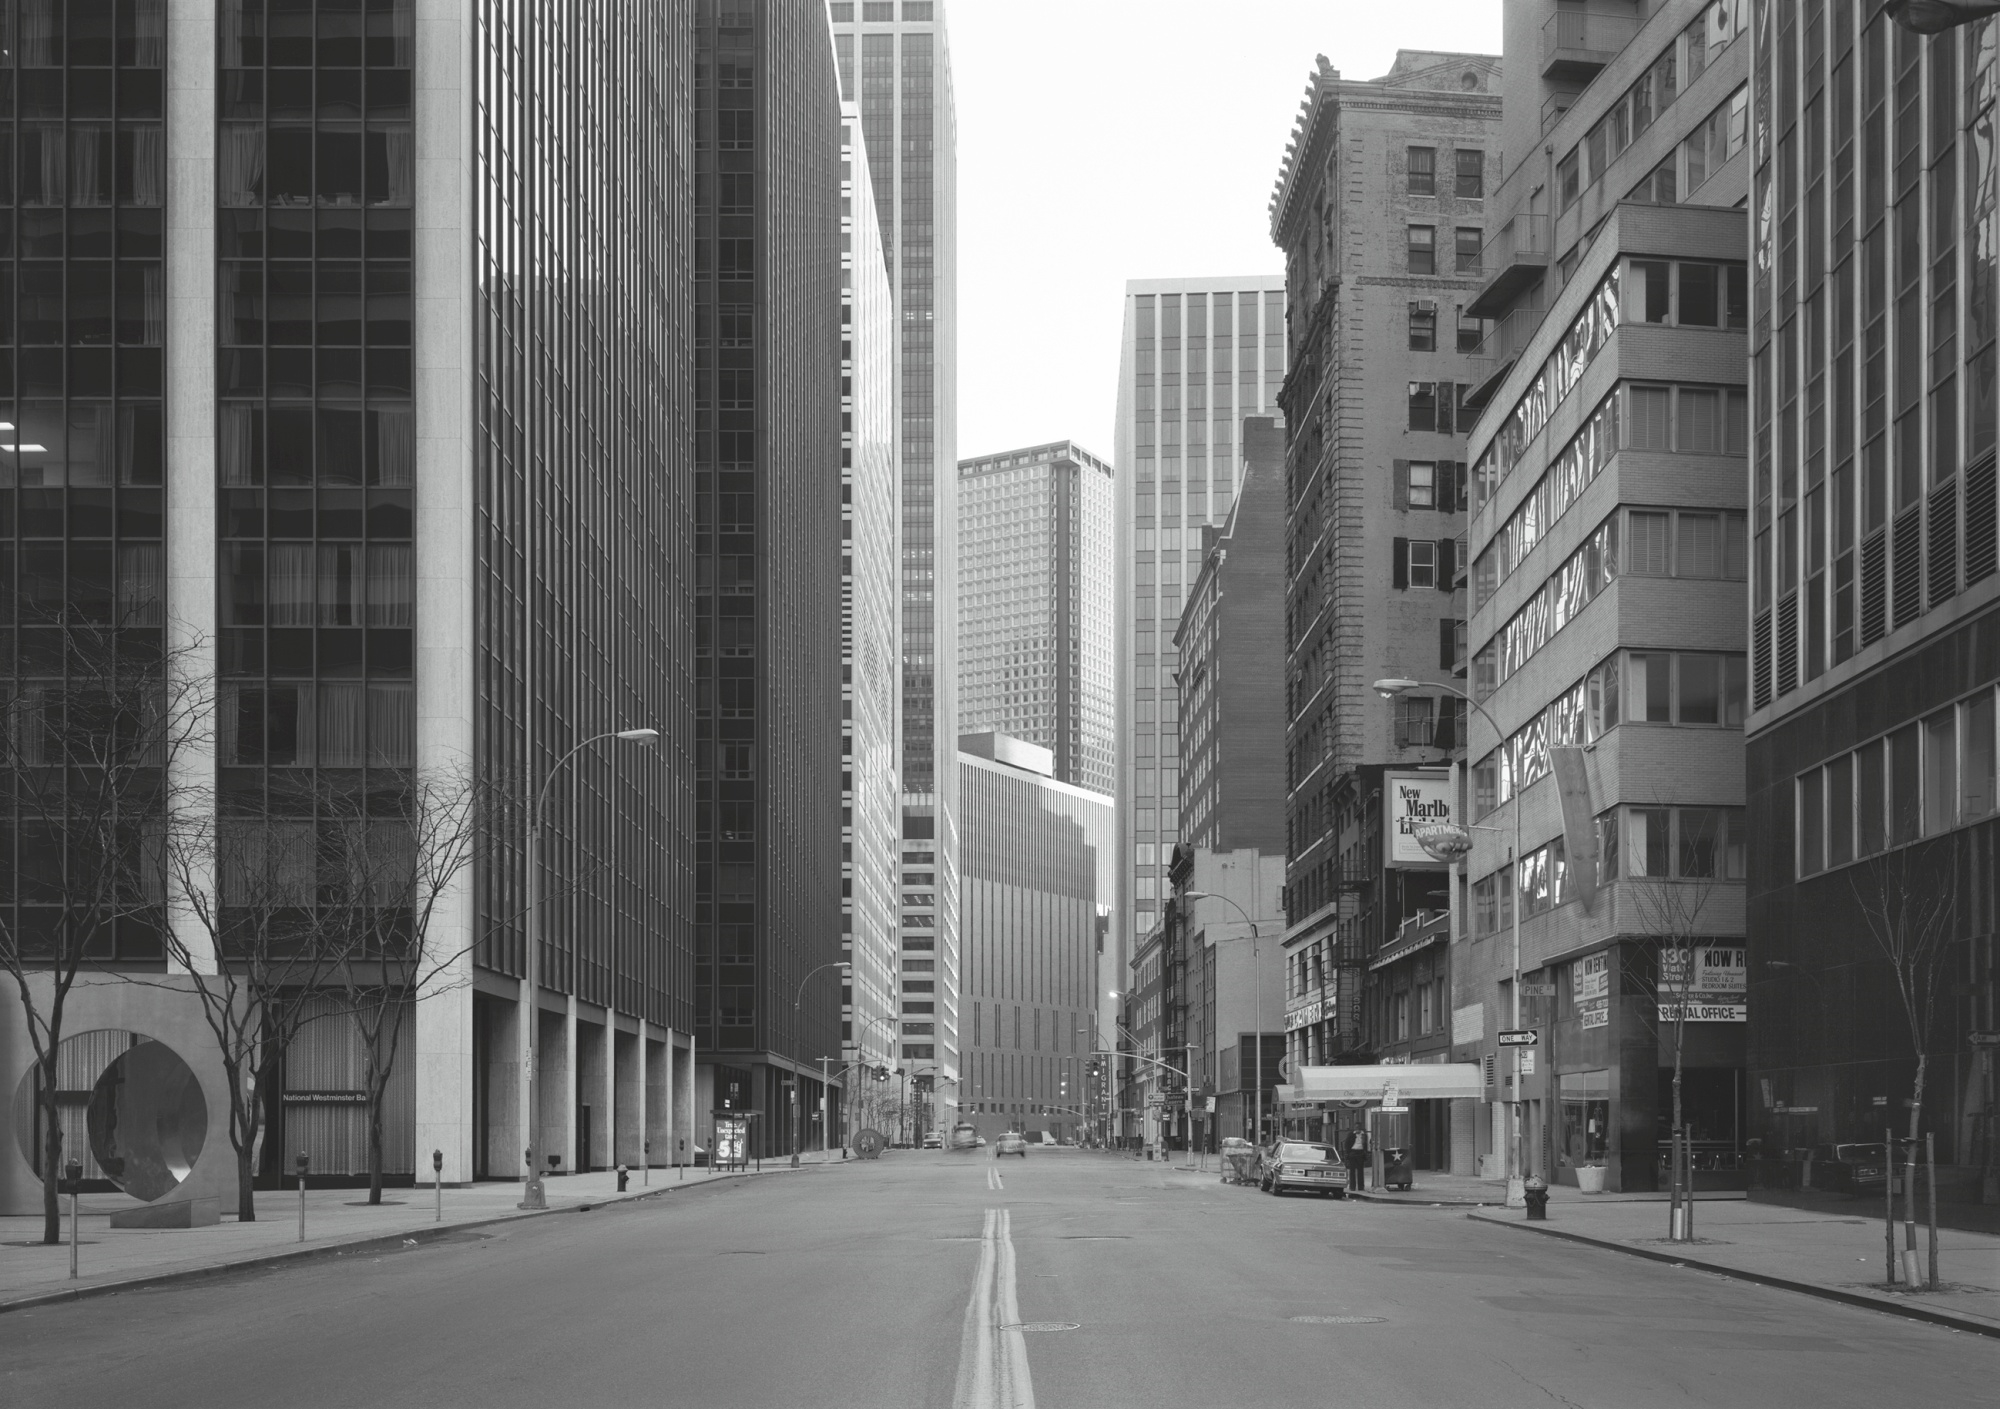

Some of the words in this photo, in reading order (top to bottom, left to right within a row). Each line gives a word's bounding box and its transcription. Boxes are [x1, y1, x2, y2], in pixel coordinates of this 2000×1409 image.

[1399, 786, 1421, 799] New
[1660, 948, 1691, 964] 130
[1704, 950, 1732, 968] NOW
[1662, 964, 1690, 972] Wat
[1525, 986, 1544, 995] PINE
[1701, 1007, 1735, 1019] OFFICE
[1501, 1035, 1514, 1043] ONE
[1521, 1034, 1532, 1042] WAY
[718, 1140, 731, 1158] 5
